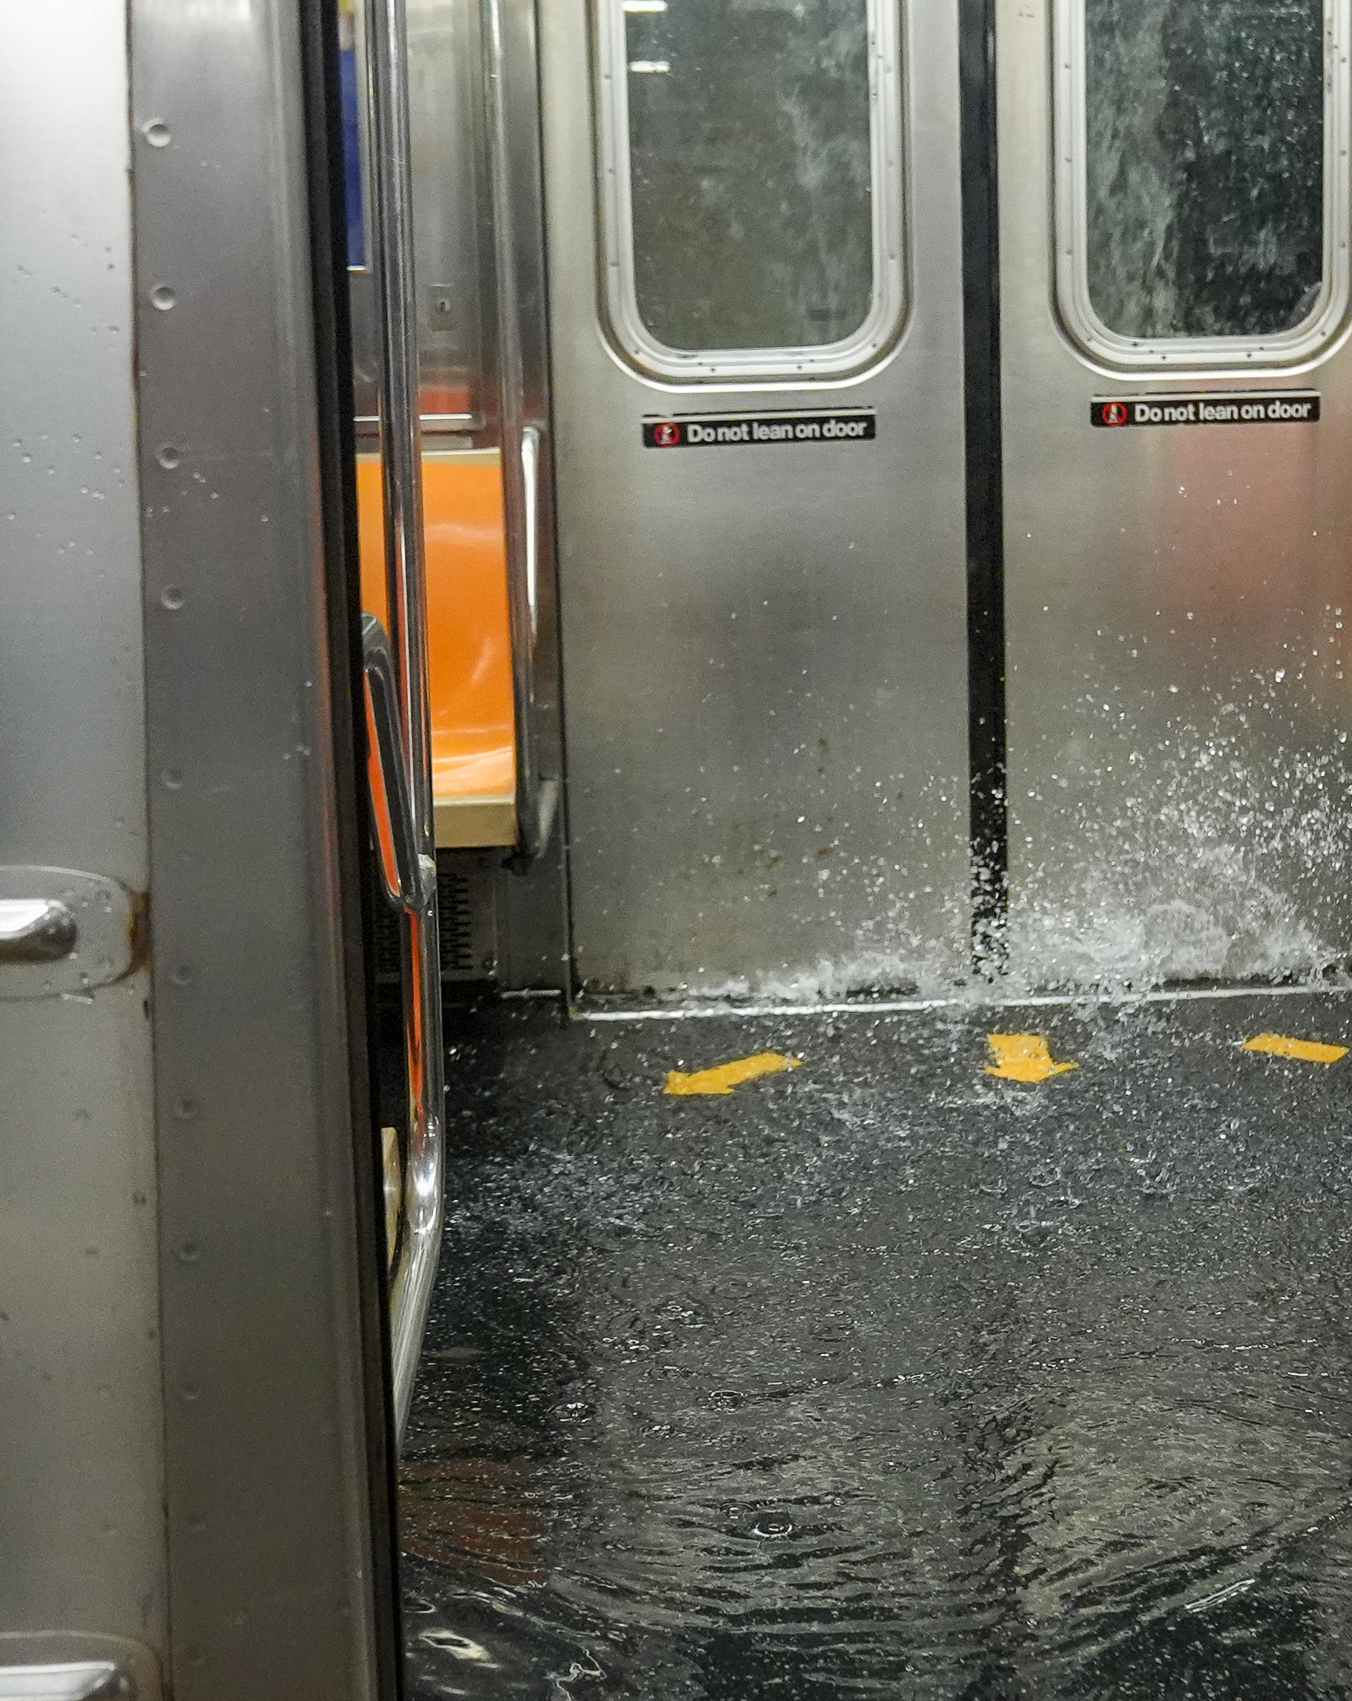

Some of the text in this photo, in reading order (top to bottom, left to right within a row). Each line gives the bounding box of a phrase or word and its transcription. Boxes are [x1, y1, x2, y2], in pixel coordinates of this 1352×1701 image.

[1134, 400, 1312, 423] Do not lean on door
[686, 419, 868, 443] Do not lean on door
